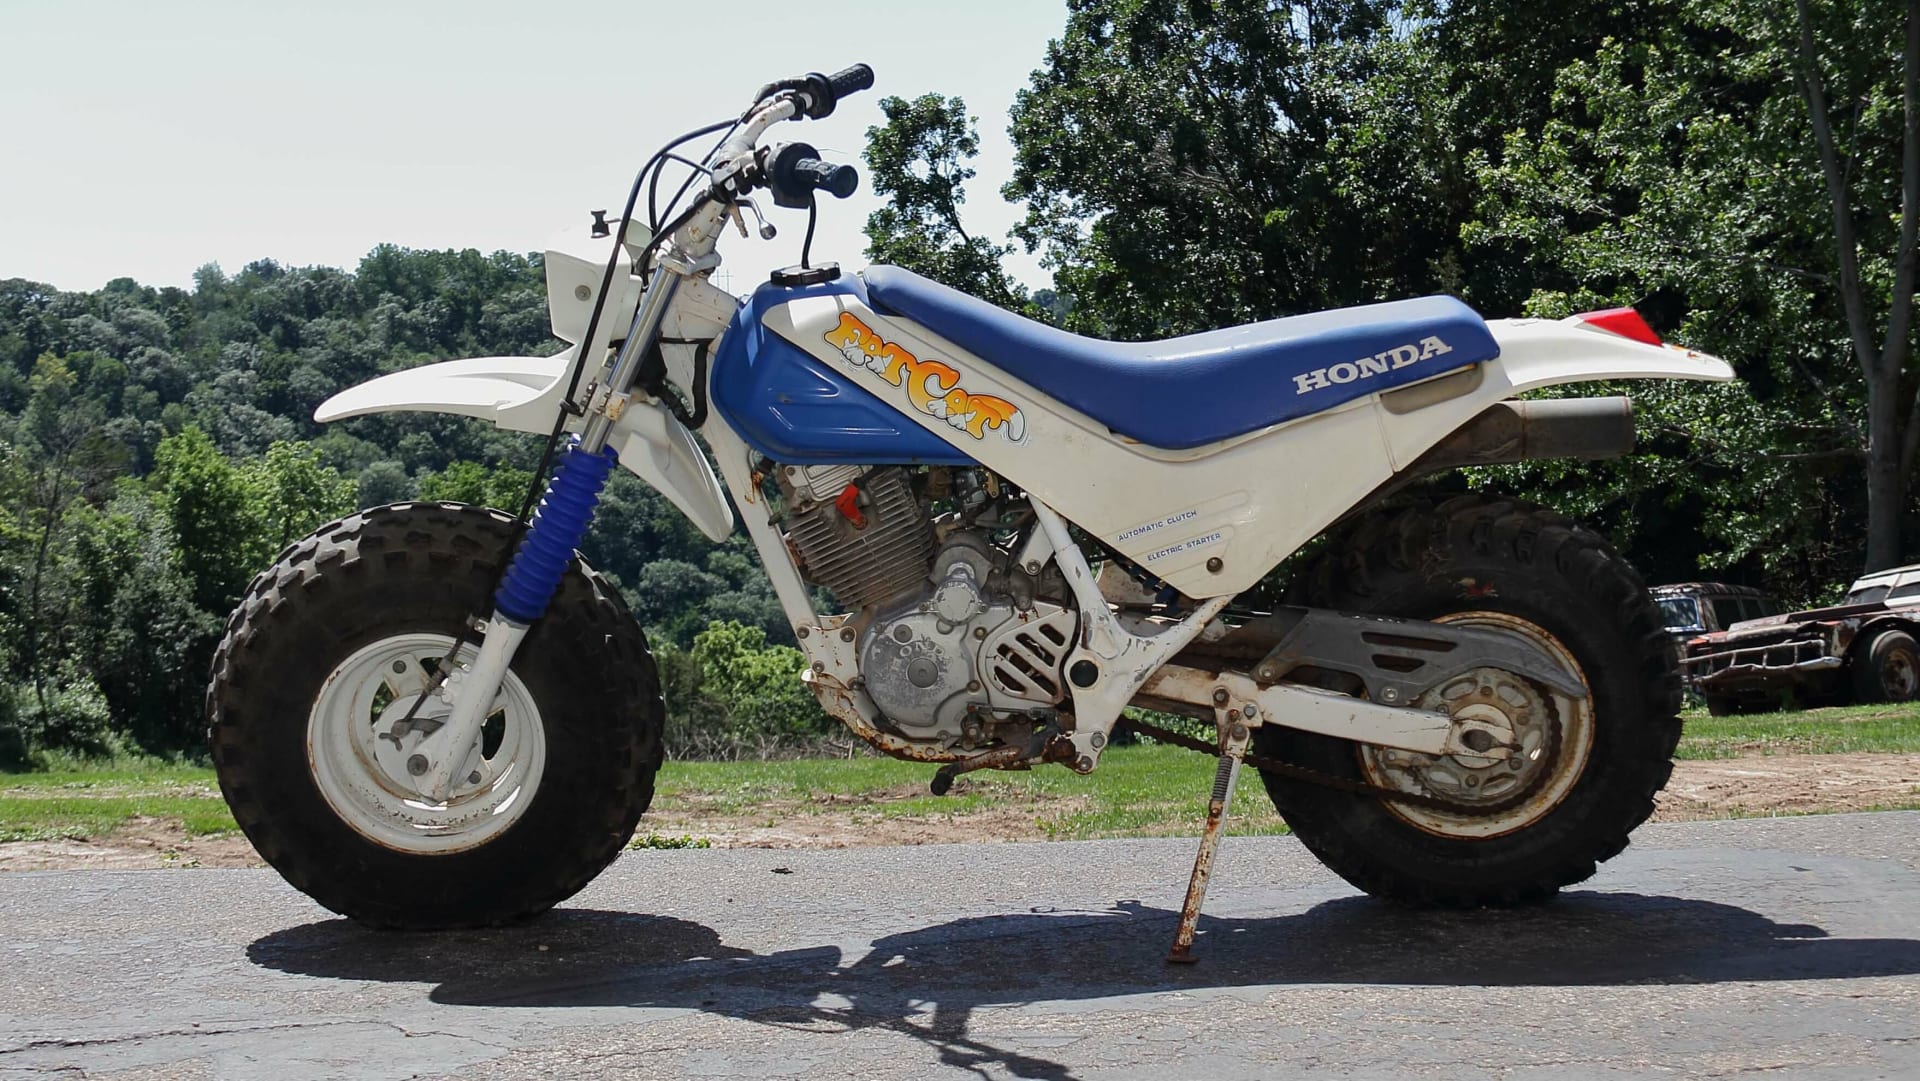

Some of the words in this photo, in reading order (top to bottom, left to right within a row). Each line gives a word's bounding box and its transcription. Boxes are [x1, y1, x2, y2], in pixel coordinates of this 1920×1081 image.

[1292, 335, 1453, 394] HONDA
[1117, 521, 1164, 542] AUTOMATIC
[1166, 510, 1198, 526] CLUTCH
[1147, 545, 1184, 561] ELECTRIC
[1186, 532, 1222, 549] STARTER
